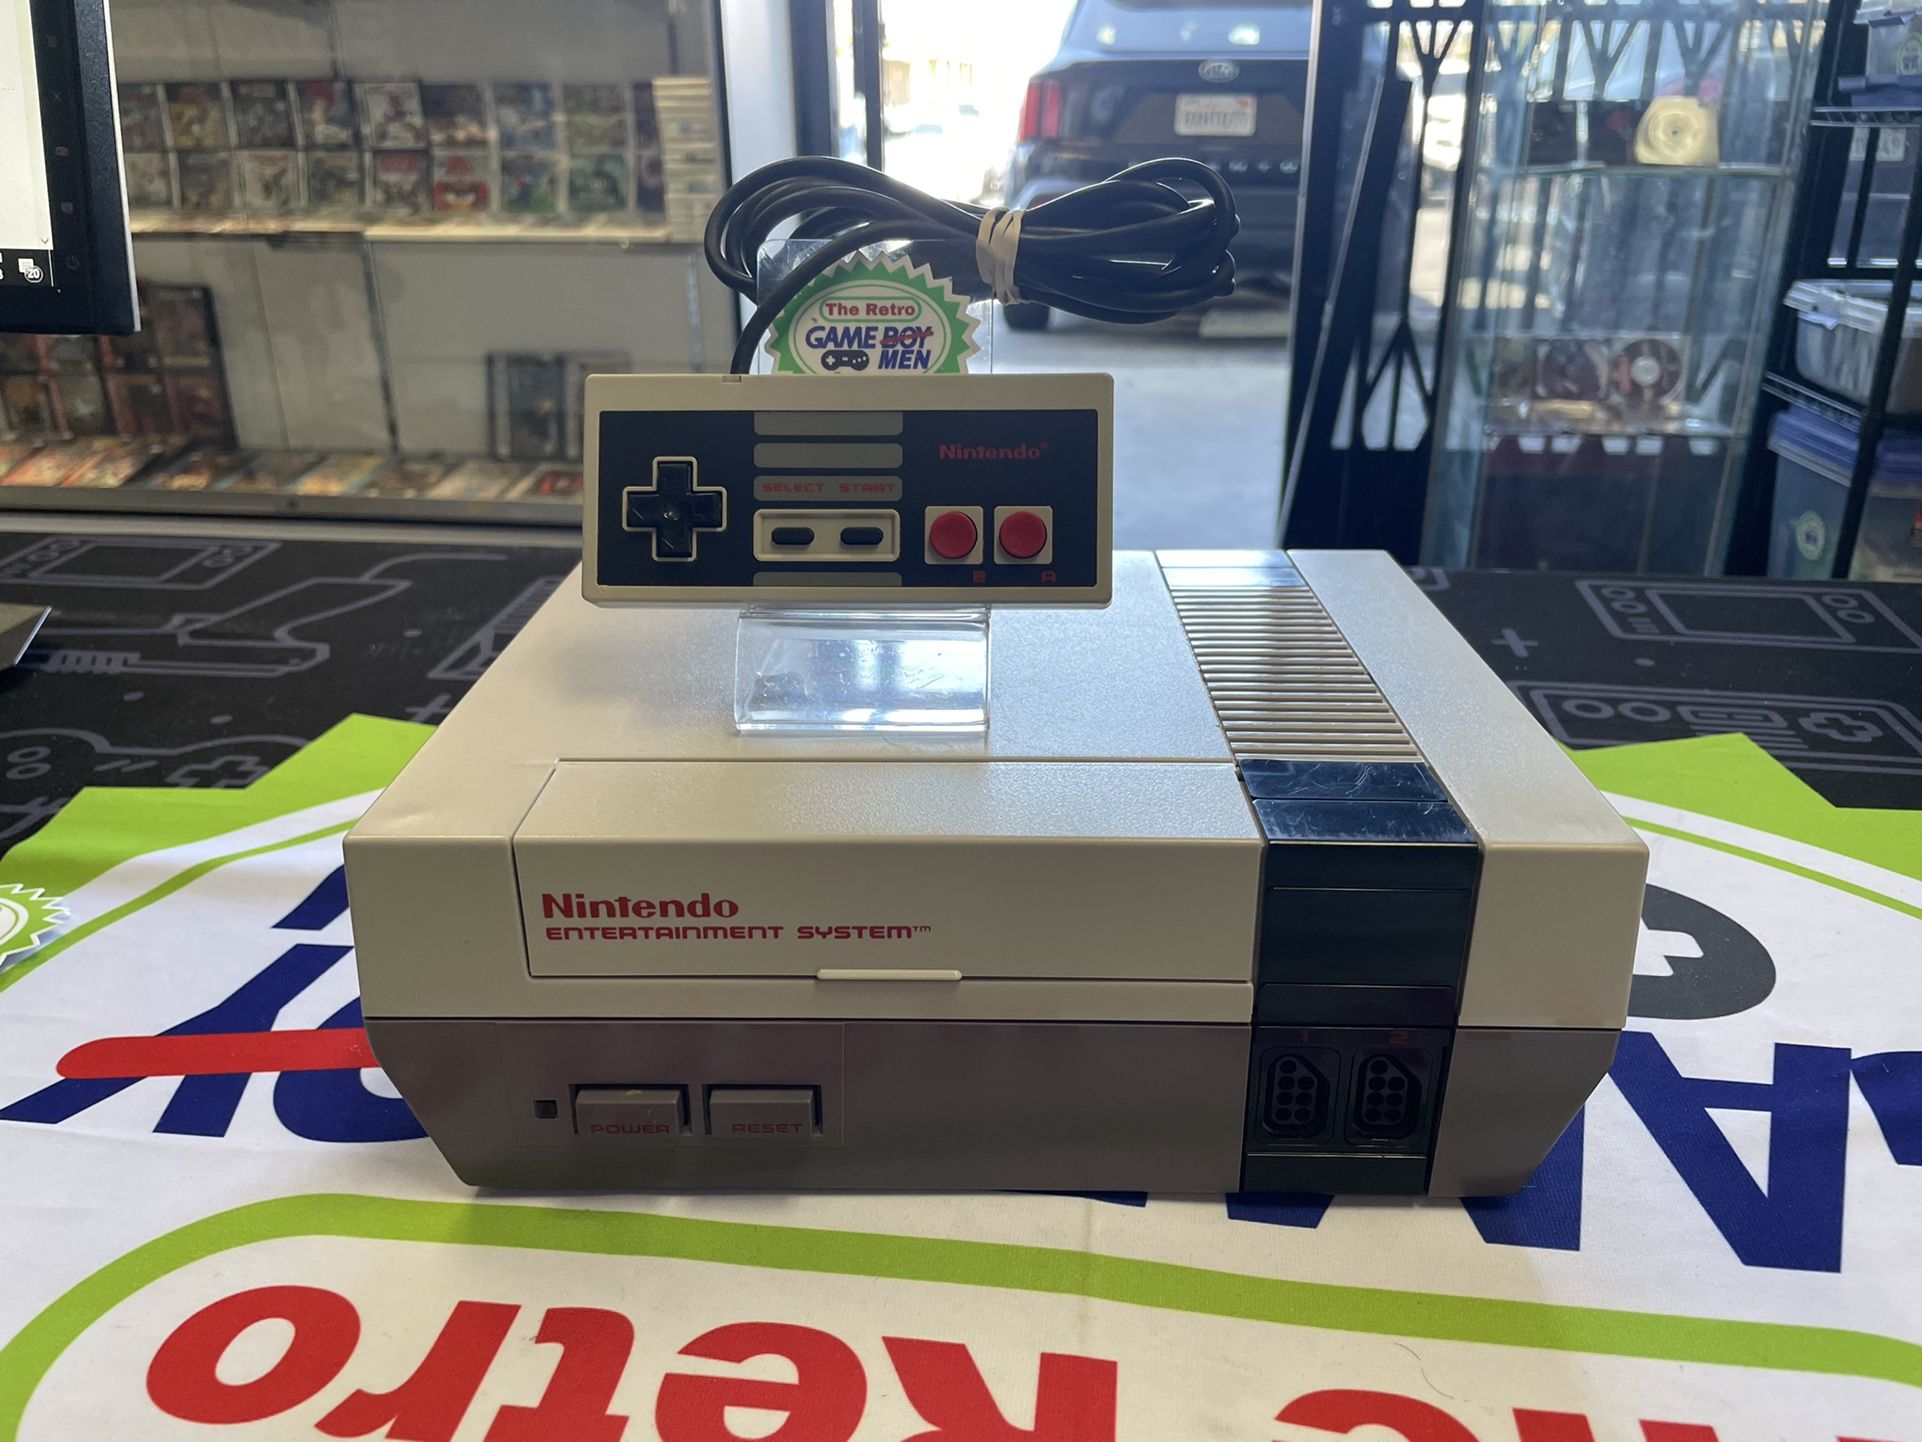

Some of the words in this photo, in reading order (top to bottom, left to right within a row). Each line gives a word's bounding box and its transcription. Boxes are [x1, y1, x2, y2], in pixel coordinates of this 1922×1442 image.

[825, 302, 860, 316] The
[865, 302, 916, 316] Retro
[805, 325, 879, 350] GAME
[880, 325, 933, 350] BOY
[877, 349, 932, 370] MEN
[762, 482, 825, 493] SELECT
[838, 482, 896, 493] START
[972, 570, 986, 583] B
[1041, 570, 1056, 583] A
[541, 893, 739, 919] Nintendo
[545, 926, 784, 940] ENTERTAINMENT
[590, 1123, 670, 1134] POWER
[731, 1123, 803, 1134] RESET
